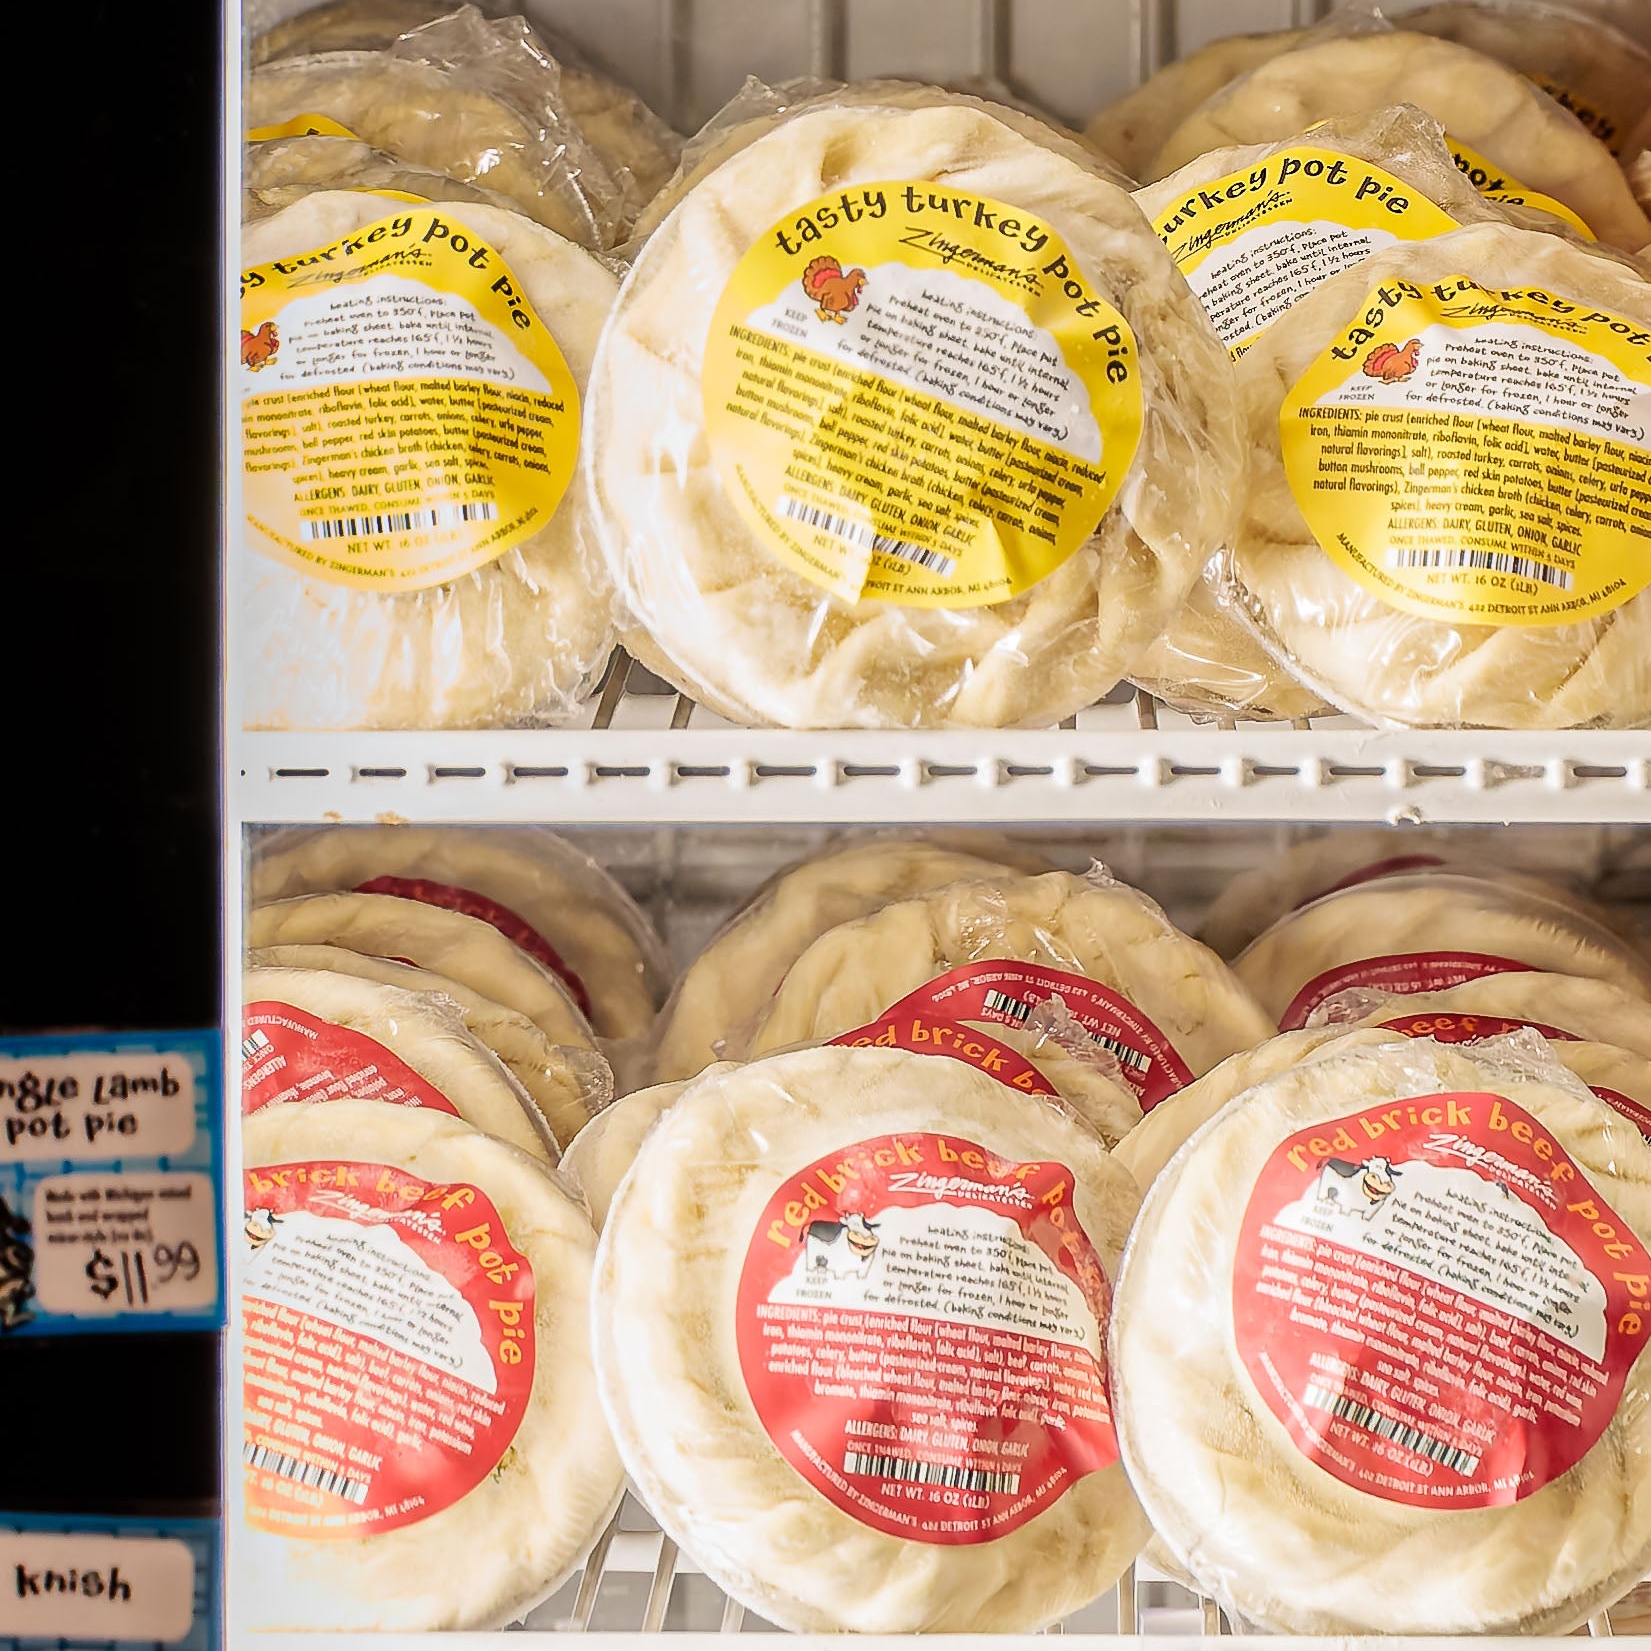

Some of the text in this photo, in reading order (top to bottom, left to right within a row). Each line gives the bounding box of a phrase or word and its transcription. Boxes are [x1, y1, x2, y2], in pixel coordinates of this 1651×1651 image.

[1278, 157, 1349, 186] pot
[1355, 175, 1410, 215] pie
[272, 215, 532, 331] turkey pot pie
[774, 186, 1130, 386] tasty turkey pot pie
[1329, 280, 1424, 363] tasty
[1582, 313, 1651, 346] pot
[911, 1020, 1011, 1072] brick
[5, 1112, 139, 1146] pot pie
[765, 1182, 822, 1250] red
[826, 1140, 925, 1193] brick
[1285, 1126, 1357, 1173] red
[1362, 1099, 1472, 1141] brick
[1489, 1101, 1575, 1184] beef
[1565, 1199, 1627, 1260] pot
[1613, 1270, 1649, 1337] pie
[250, 1165, 360, 1194] brick
[456, 1222, 521, 1285] pot
[489, 1300, 525, 1365] pie
[15, 1563, 131, 1601] knish
